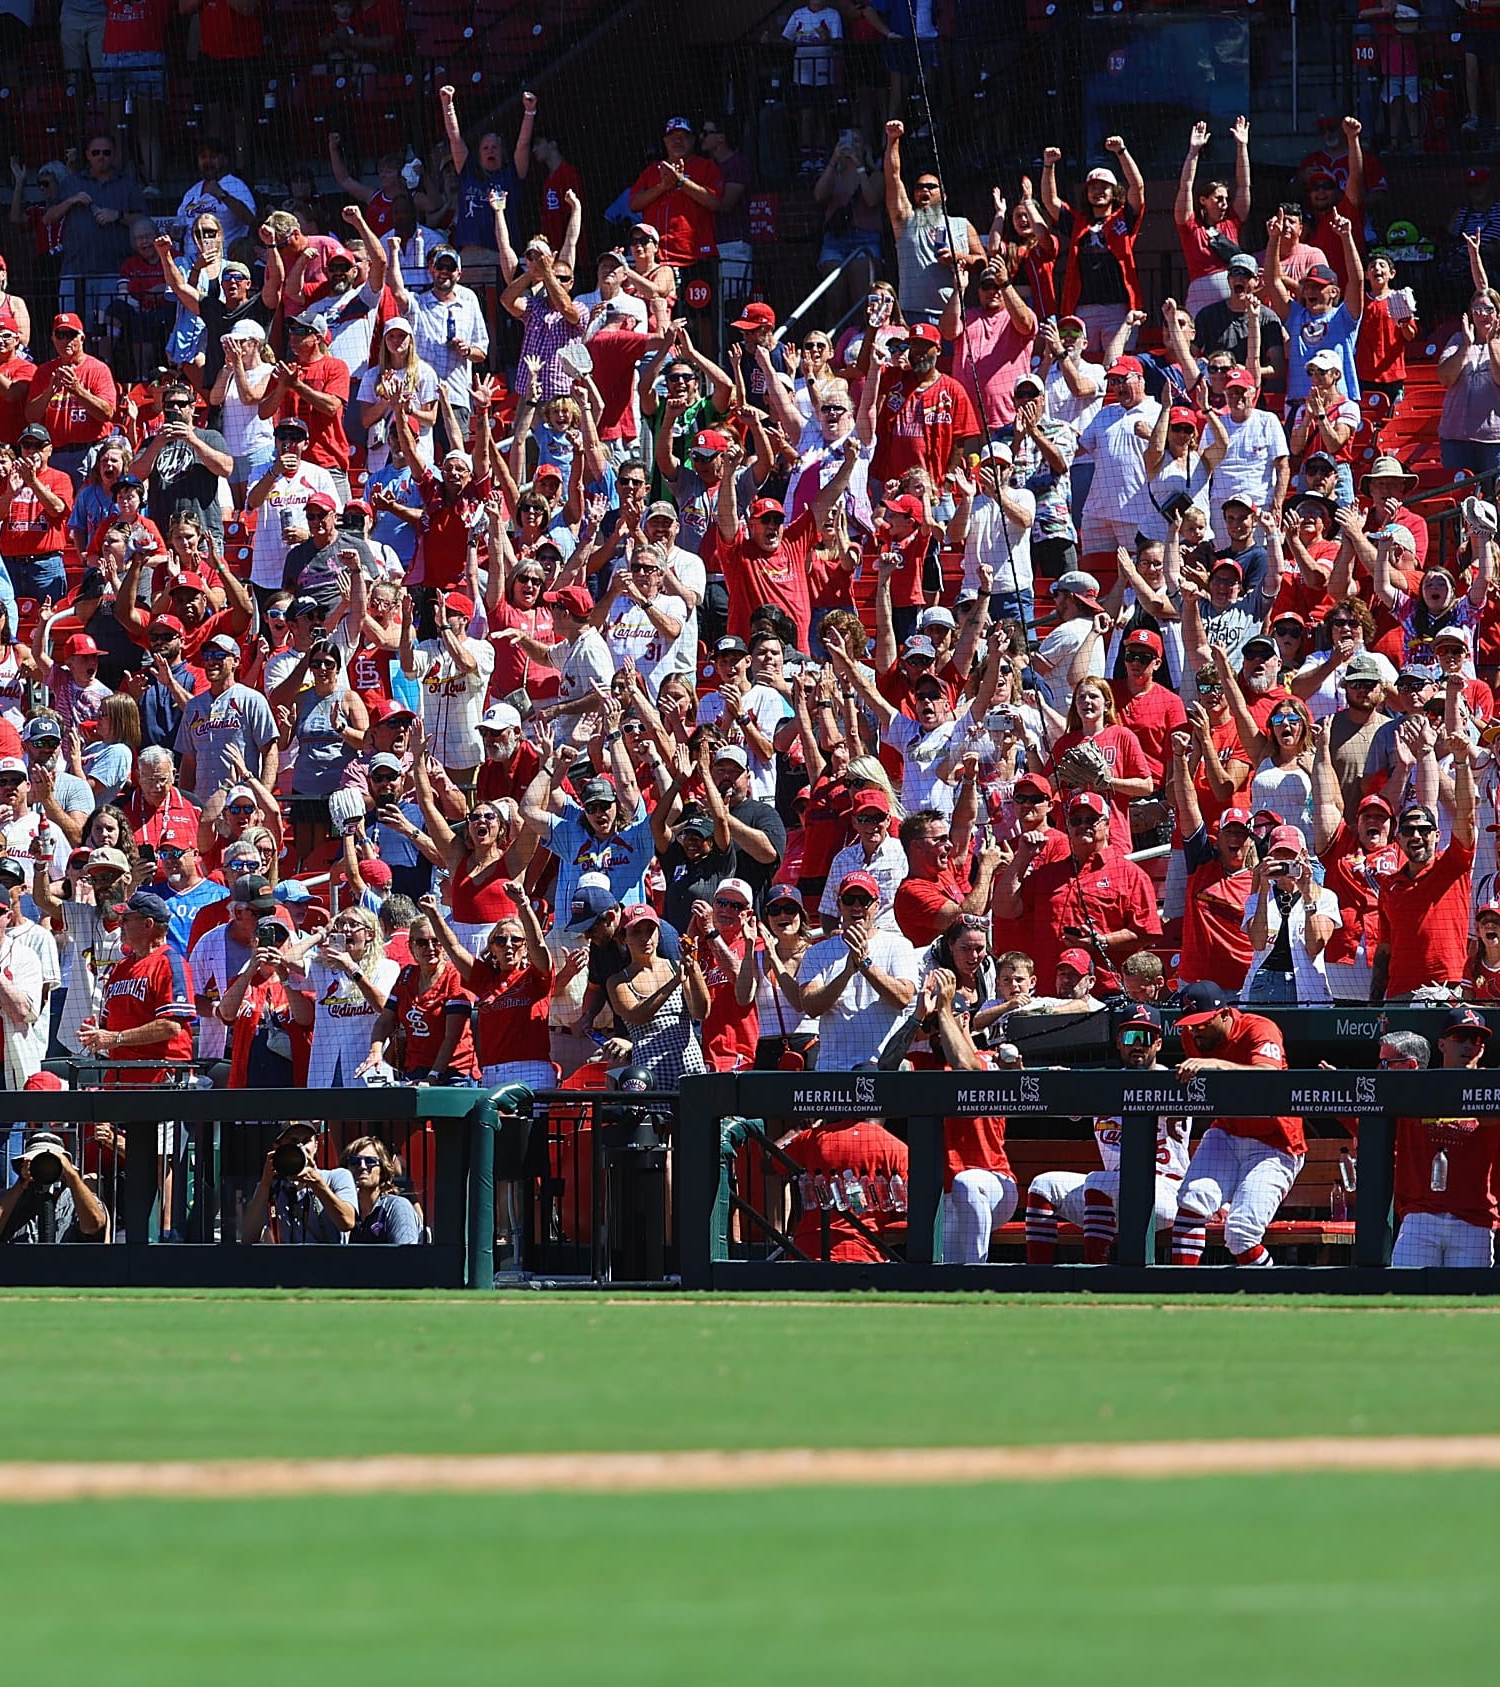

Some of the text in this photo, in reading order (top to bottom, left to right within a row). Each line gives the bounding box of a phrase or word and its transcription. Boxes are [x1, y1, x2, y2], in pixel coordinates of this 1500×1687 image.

[1356, 48, 1373, 60] 140
[689, 287, 707, 301] 139
[71, 408, 87, 423] 55
[614, 627, 660, 640] Cardinals
[644, 642, 662, 662] 31
[195, 714, 241, 737] Cardinals
[598, 856, 630, 873] Louis
[108, 977, 149, 1003] CARDINALS
[1337, 1018, 1378, 1040] Mercy
[1259, 1041, 1281, 1061] 48
[793, 1090, 853, 1103] MERRILL
[957, 1089, 1017, 1102] MERRILL
[1123, 1089, 1184, 1102] MERRILL
[1291, 1090, 1353, 1103] MERRILL
